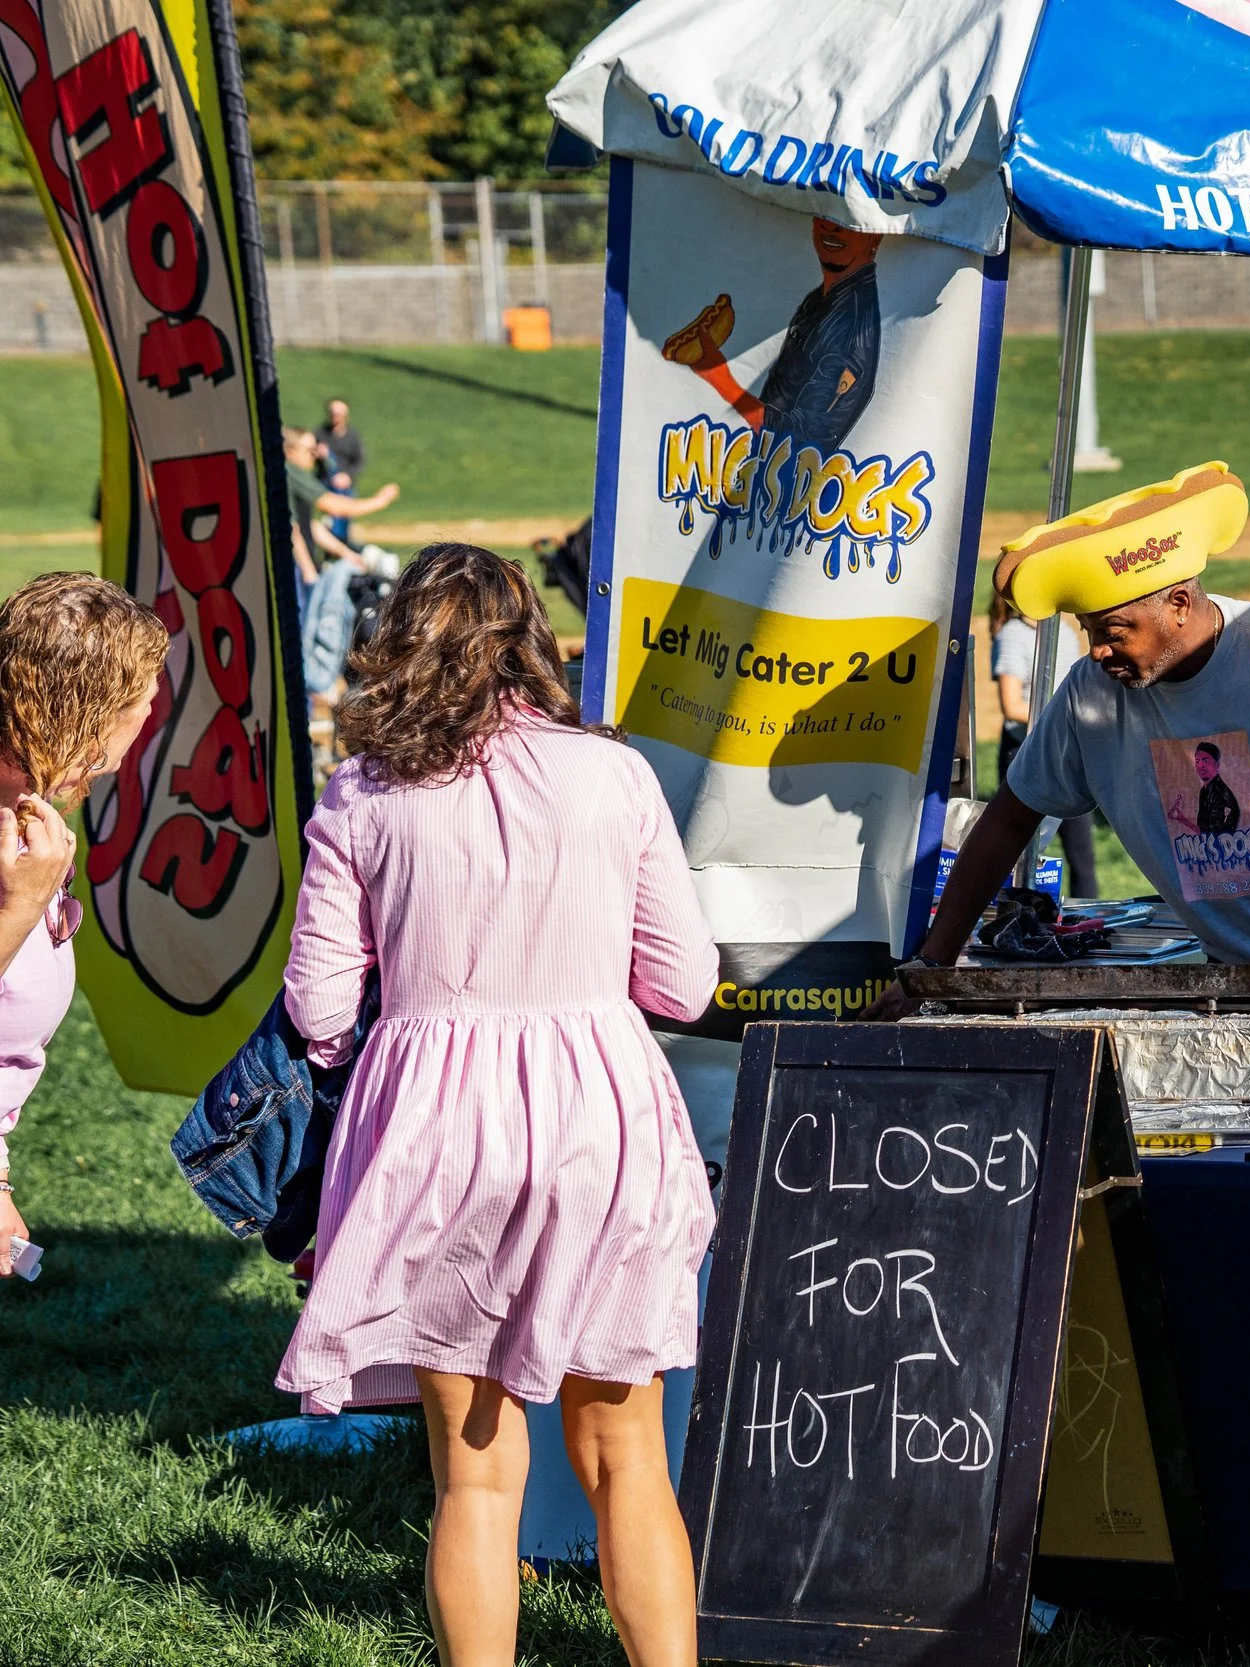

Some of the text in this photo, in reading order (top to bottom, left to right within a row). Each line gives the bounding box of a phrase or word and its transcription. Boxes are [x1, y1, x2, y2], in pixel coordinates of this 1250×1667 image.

[763, 134, 948, 208] DRINKS
[663, 419, 932, 540] MIG'S DOGS
[641, 616, 917, 687] Let Mig Cater 2 U
[704, 708, 716, 724] to
[714, 711, 752, 737] you,
[759, 714, 777, 736] is
[783, 713, 840, 736] what
[843, 712, 855, 732] I
[774, 1112, 1040, 1206] CLOSED
[788, 1237, 960, 1366] FOR
[742, 1359, 876, 1479] HOT
